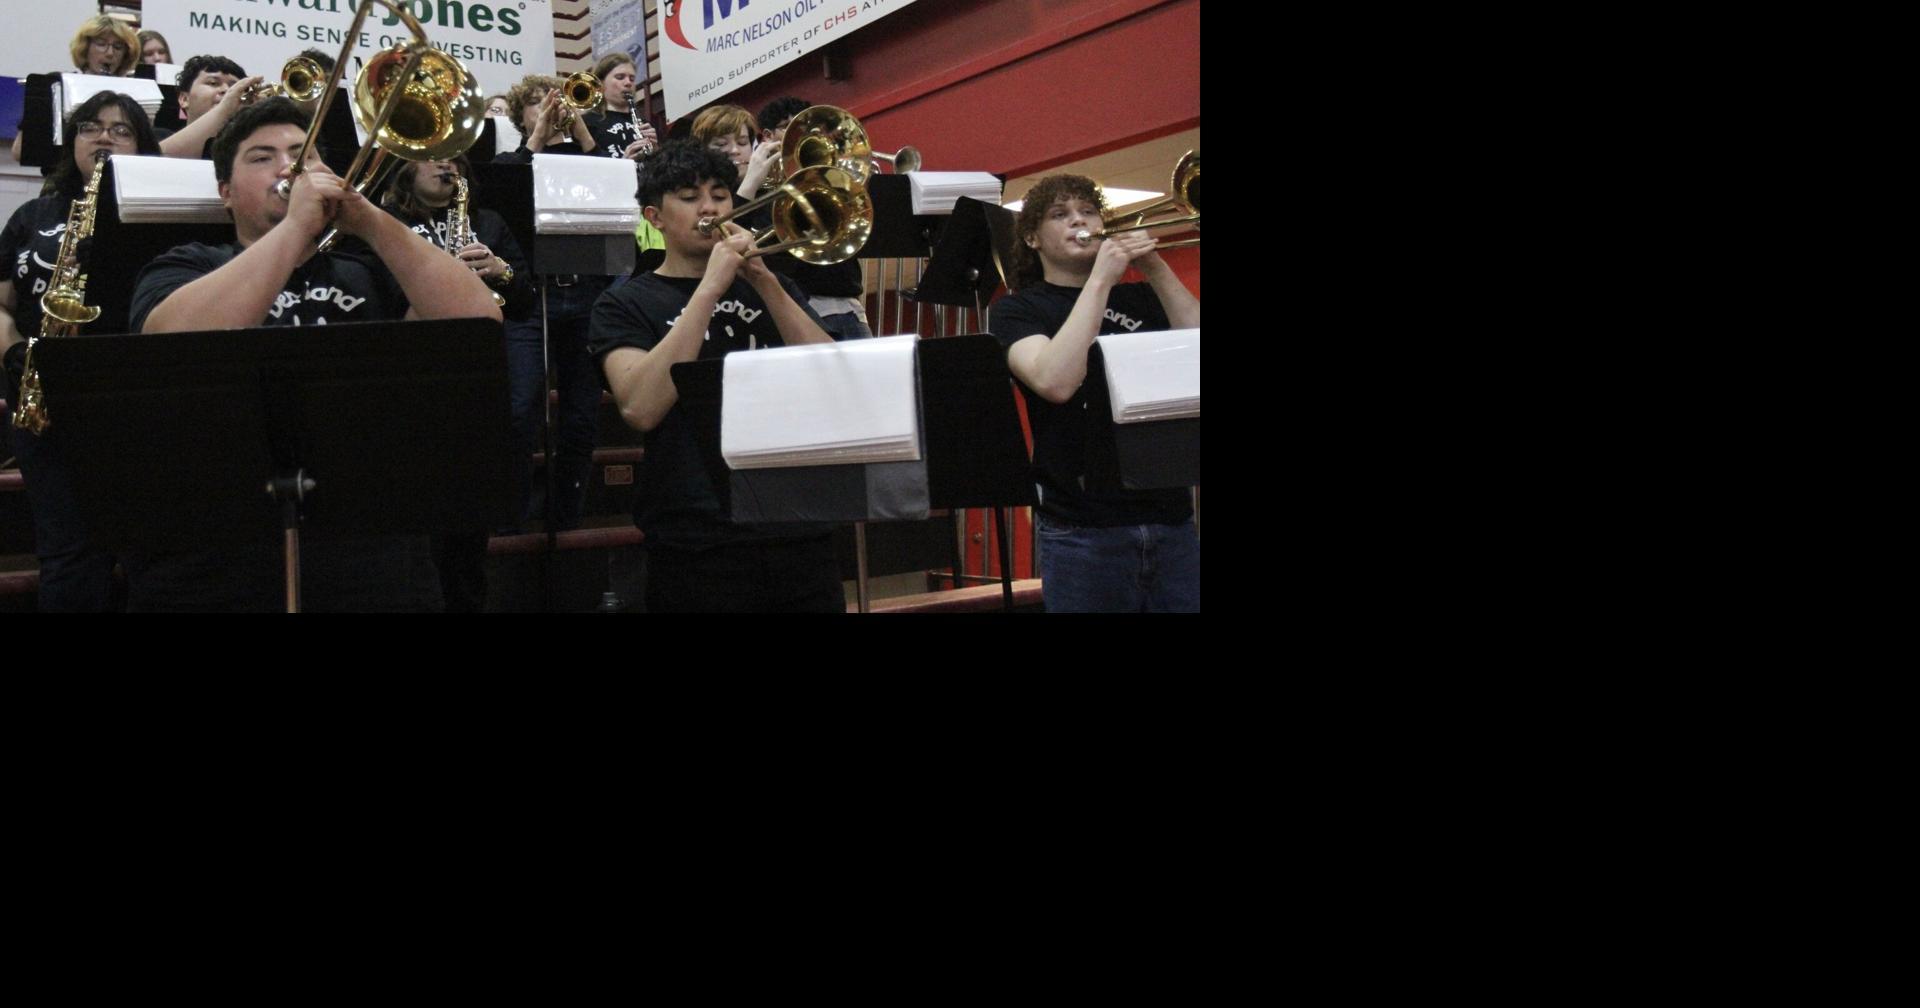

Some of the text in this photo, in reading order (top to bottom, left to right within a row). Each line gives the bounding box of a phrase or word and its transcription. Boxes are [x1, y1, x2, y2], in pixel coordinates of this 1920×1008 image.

[189, 11, 287, 38] MAKING
[378, 34, 407, 50] O
[429, 39, 523, 66] VESTING
[687, 76, 725, 101] PROUD
[728, 36, 799, 80] SUPPORTER
[803, 24, 822, 41] OF
[824, 5, 858, 31] CHS
[706, 30, 740, 53] MARC
[742, 7, 792, 44] NELSON
[1103, 308, 1143, 332] and
